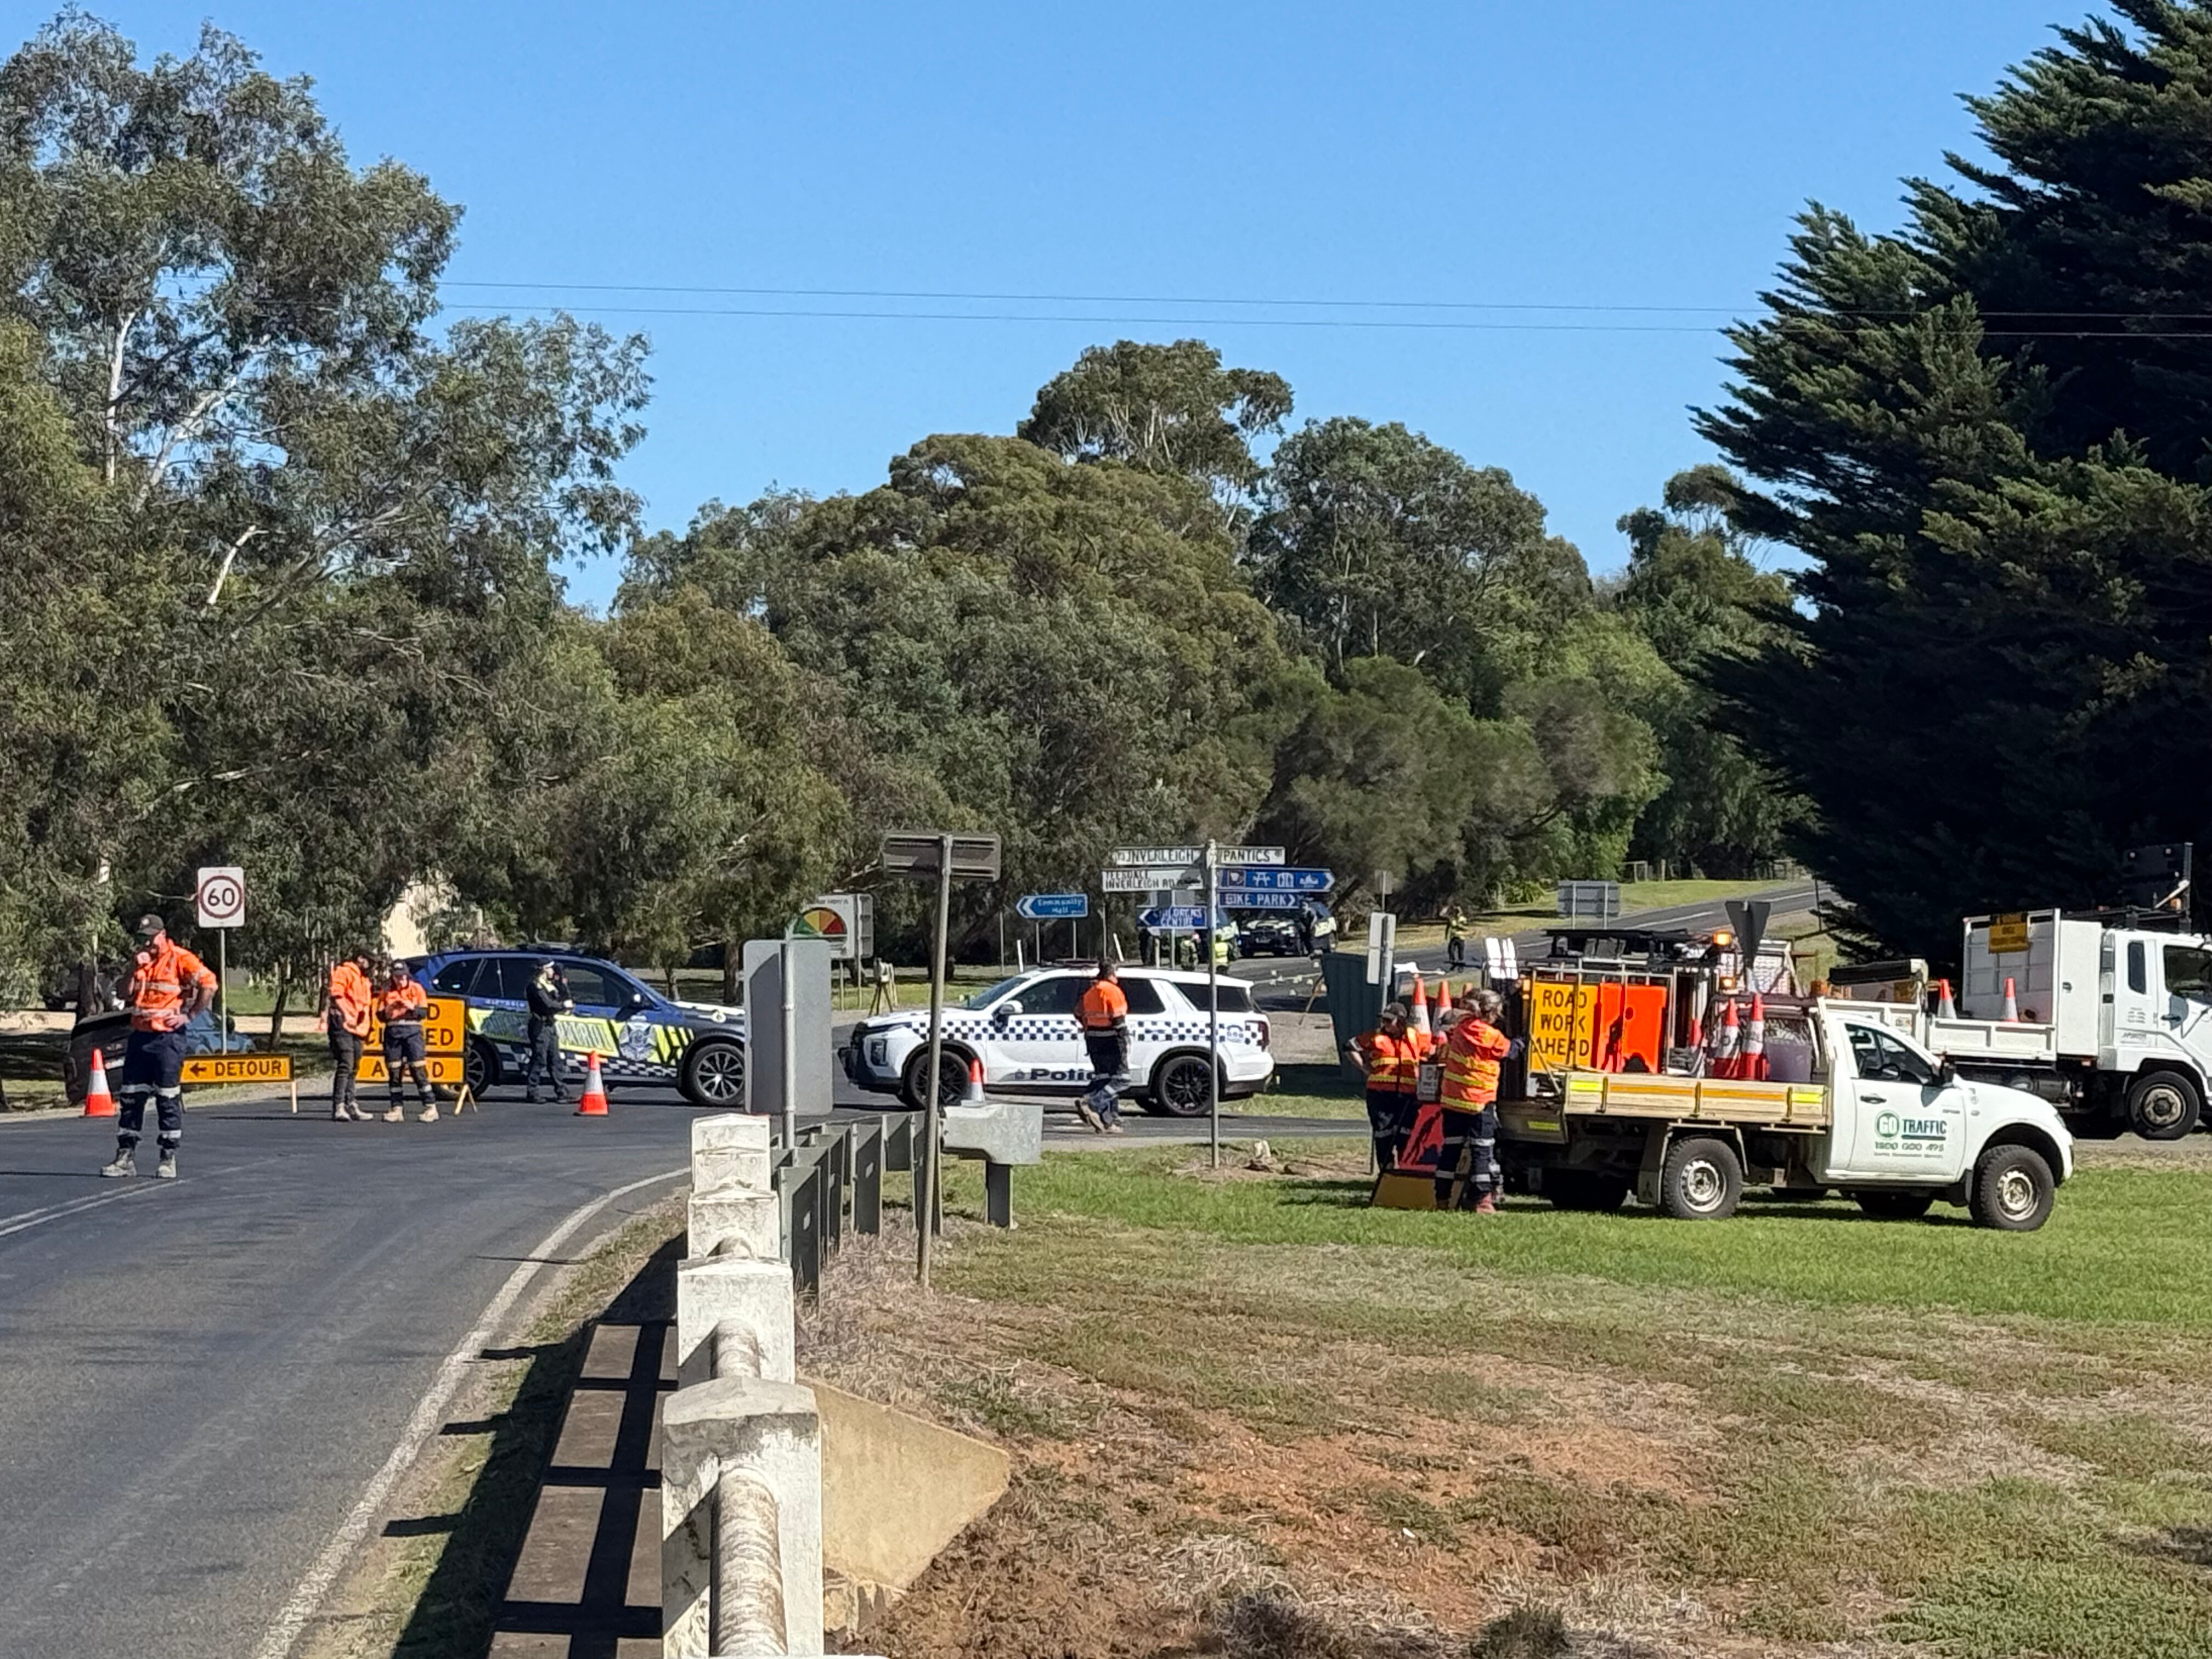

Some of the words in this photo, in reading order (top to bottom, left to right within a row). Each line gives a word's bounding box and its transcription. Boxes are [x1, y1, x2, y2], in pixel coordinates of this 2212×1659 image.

[1223, 850, 1271, 862] PANTICS
[208, 888, 235, 906] 60
[1256, 894, 1286, 906] PARK
[1543, 989, 1587, 1008] ROAD
[1541, 1013, 1586, 1033] WORK
[1532, 1036, 1589, 1056] AHEAD
[215, 1060, 282, 1076] DETOUR
[1030, 1068, 1097, 1081] Polic
[1879, 1115, 1898, 1135] GO
[1902, 1119, 1948, 1135] TRAFFIC
